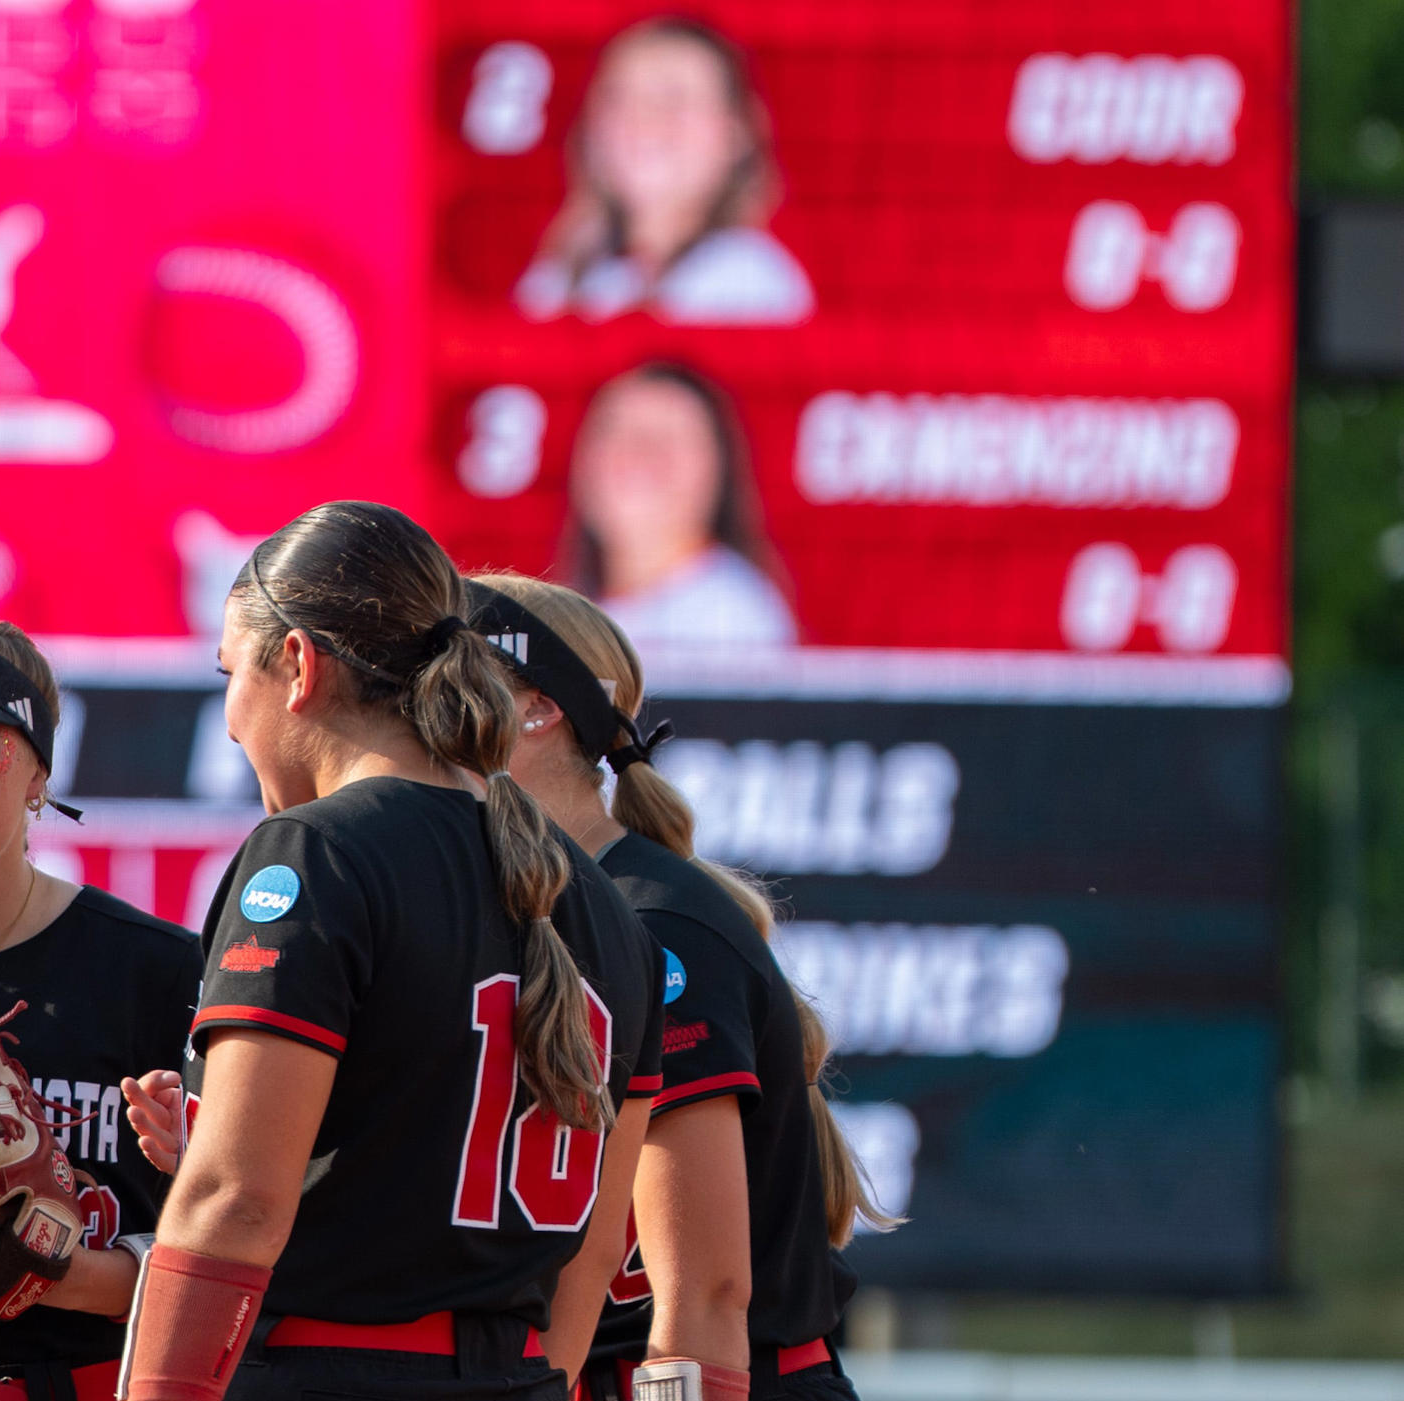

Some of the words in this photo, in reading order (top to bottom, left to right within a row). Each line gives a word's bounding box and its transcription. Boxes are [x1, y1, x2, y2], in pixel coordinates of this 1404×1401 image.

[461, 40, 554, 155] 2
[457, 385, 546, 498] 3
[245, 890, 291, 911] NCAA
